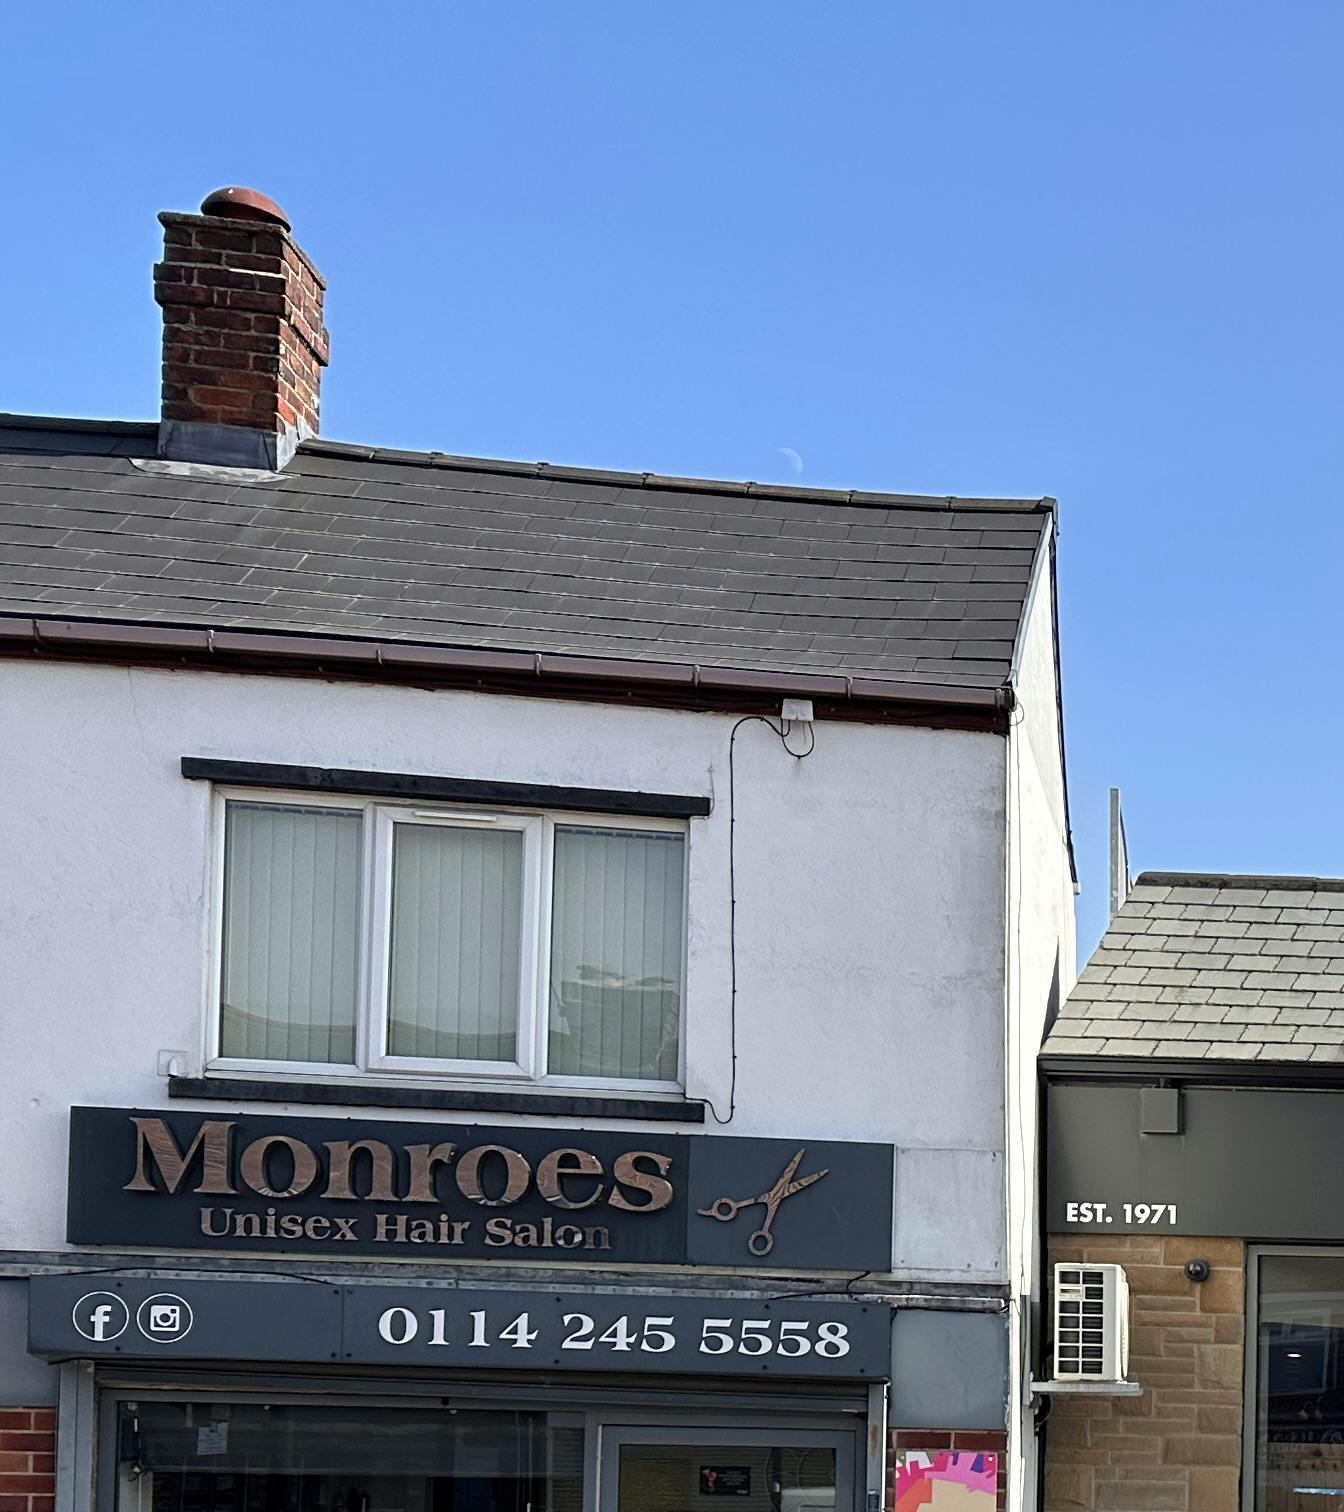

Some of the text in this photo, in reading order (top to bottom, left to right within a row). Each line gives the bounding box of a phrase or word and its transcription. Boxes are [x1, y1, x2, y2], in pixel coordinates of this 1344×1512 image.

[122, 1117, 674, 1212] Monroes
[200, 1207, 611, 1250] Unisex Hair Salon
[1066, 1202, 1177, 1225] EST. 1971
[378, 1307, 851, 1358] 0114 245 5558
